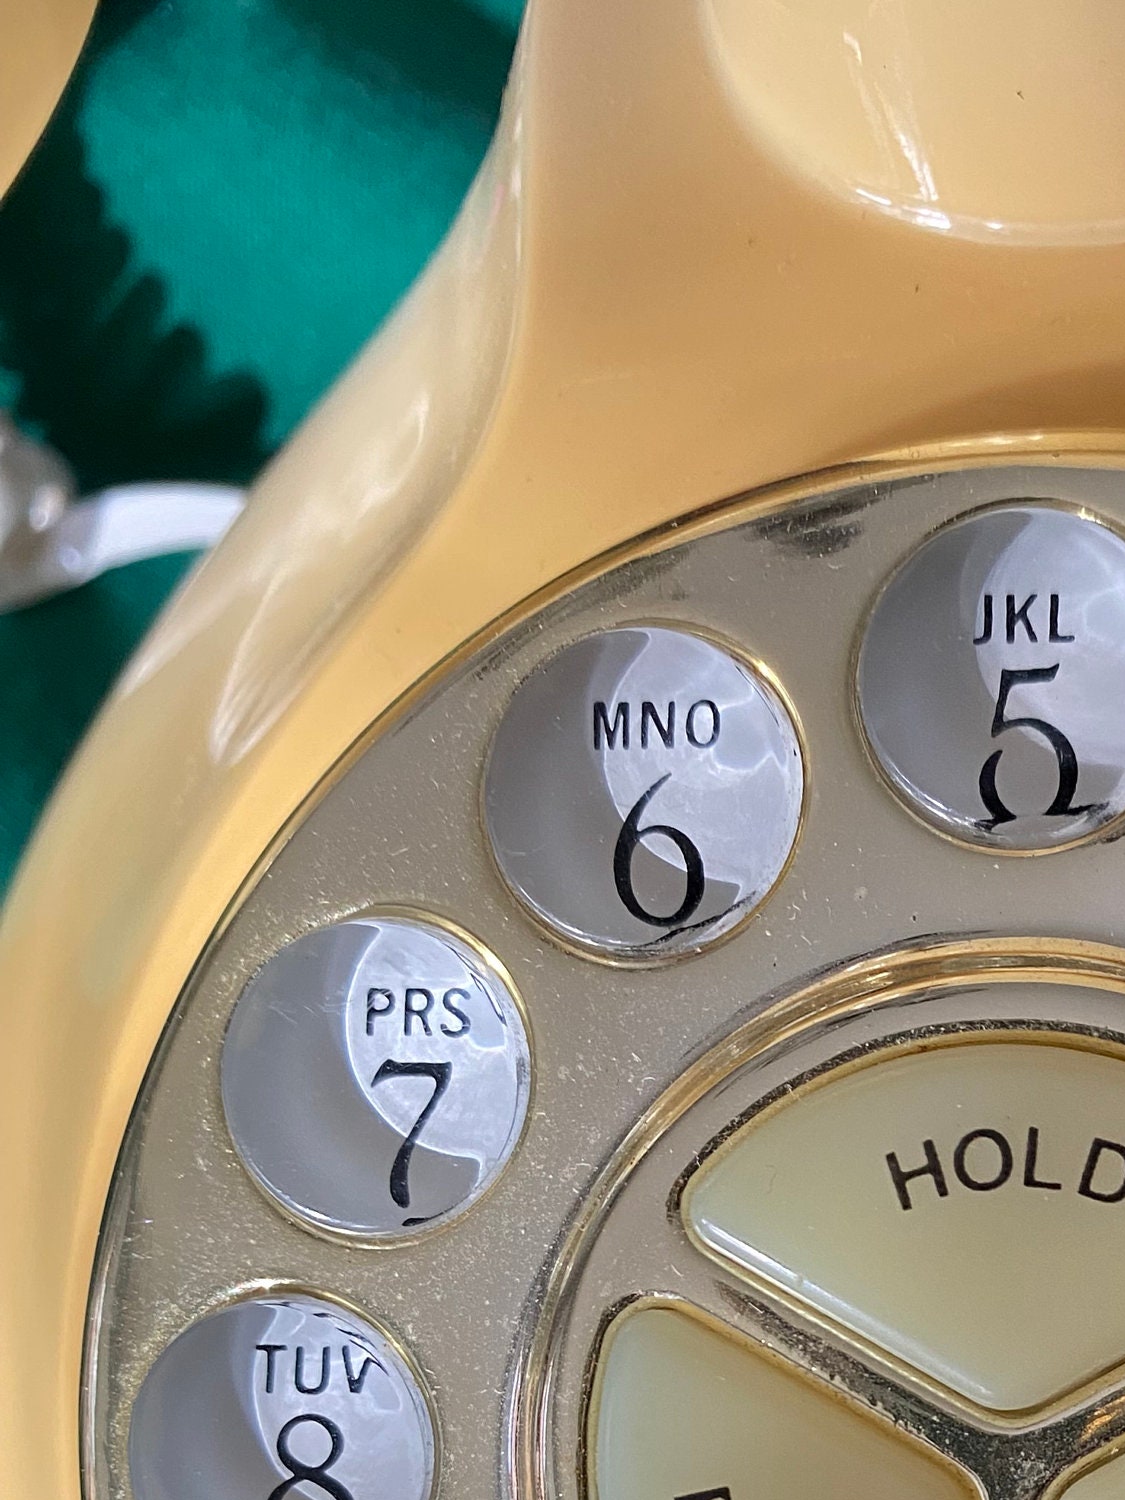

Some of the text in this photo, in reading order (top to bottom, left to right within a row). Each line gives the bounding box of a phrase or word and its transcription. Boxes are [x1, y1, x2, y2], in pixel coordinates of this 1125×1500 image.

[972, 593, 1076, 646] JKL
[592, 698, 722, 751] MNO
[976, 662, 1080, 832] 5
[612, 770, 706, 929] 6
[365, 985, 470, 1037] PRS
[371, 1063, 449, 1219] 7
[255, 1344, 382, 1395] TUV
